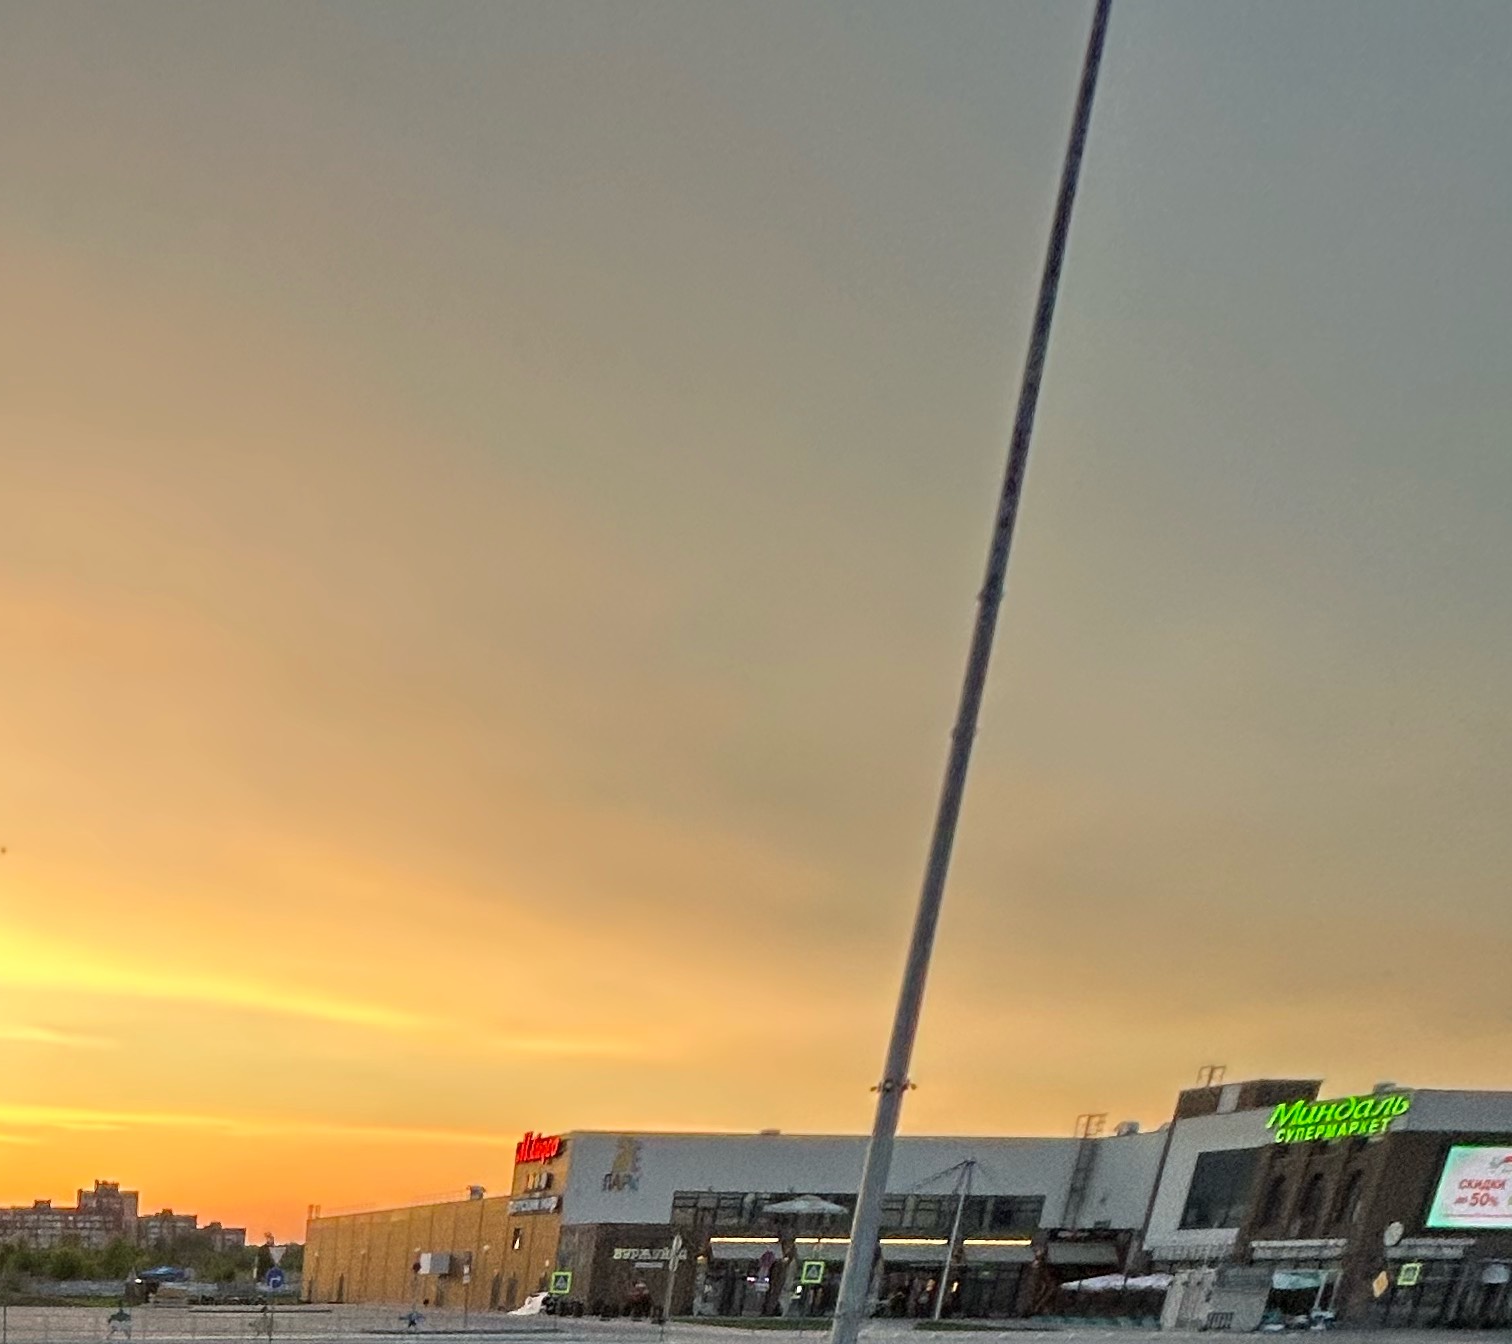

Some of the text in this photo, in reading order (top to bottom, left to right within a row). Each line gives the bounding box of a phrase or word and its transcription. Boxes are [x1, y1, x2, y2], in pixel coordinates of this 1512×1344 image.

[1265, 1096, 1410, 1129] Миндаль
[1275, 1117, 1392, 1143] СУПЕРМАРКЕТ
[1459, 1179, 1506, 1190] СКИДКИ
